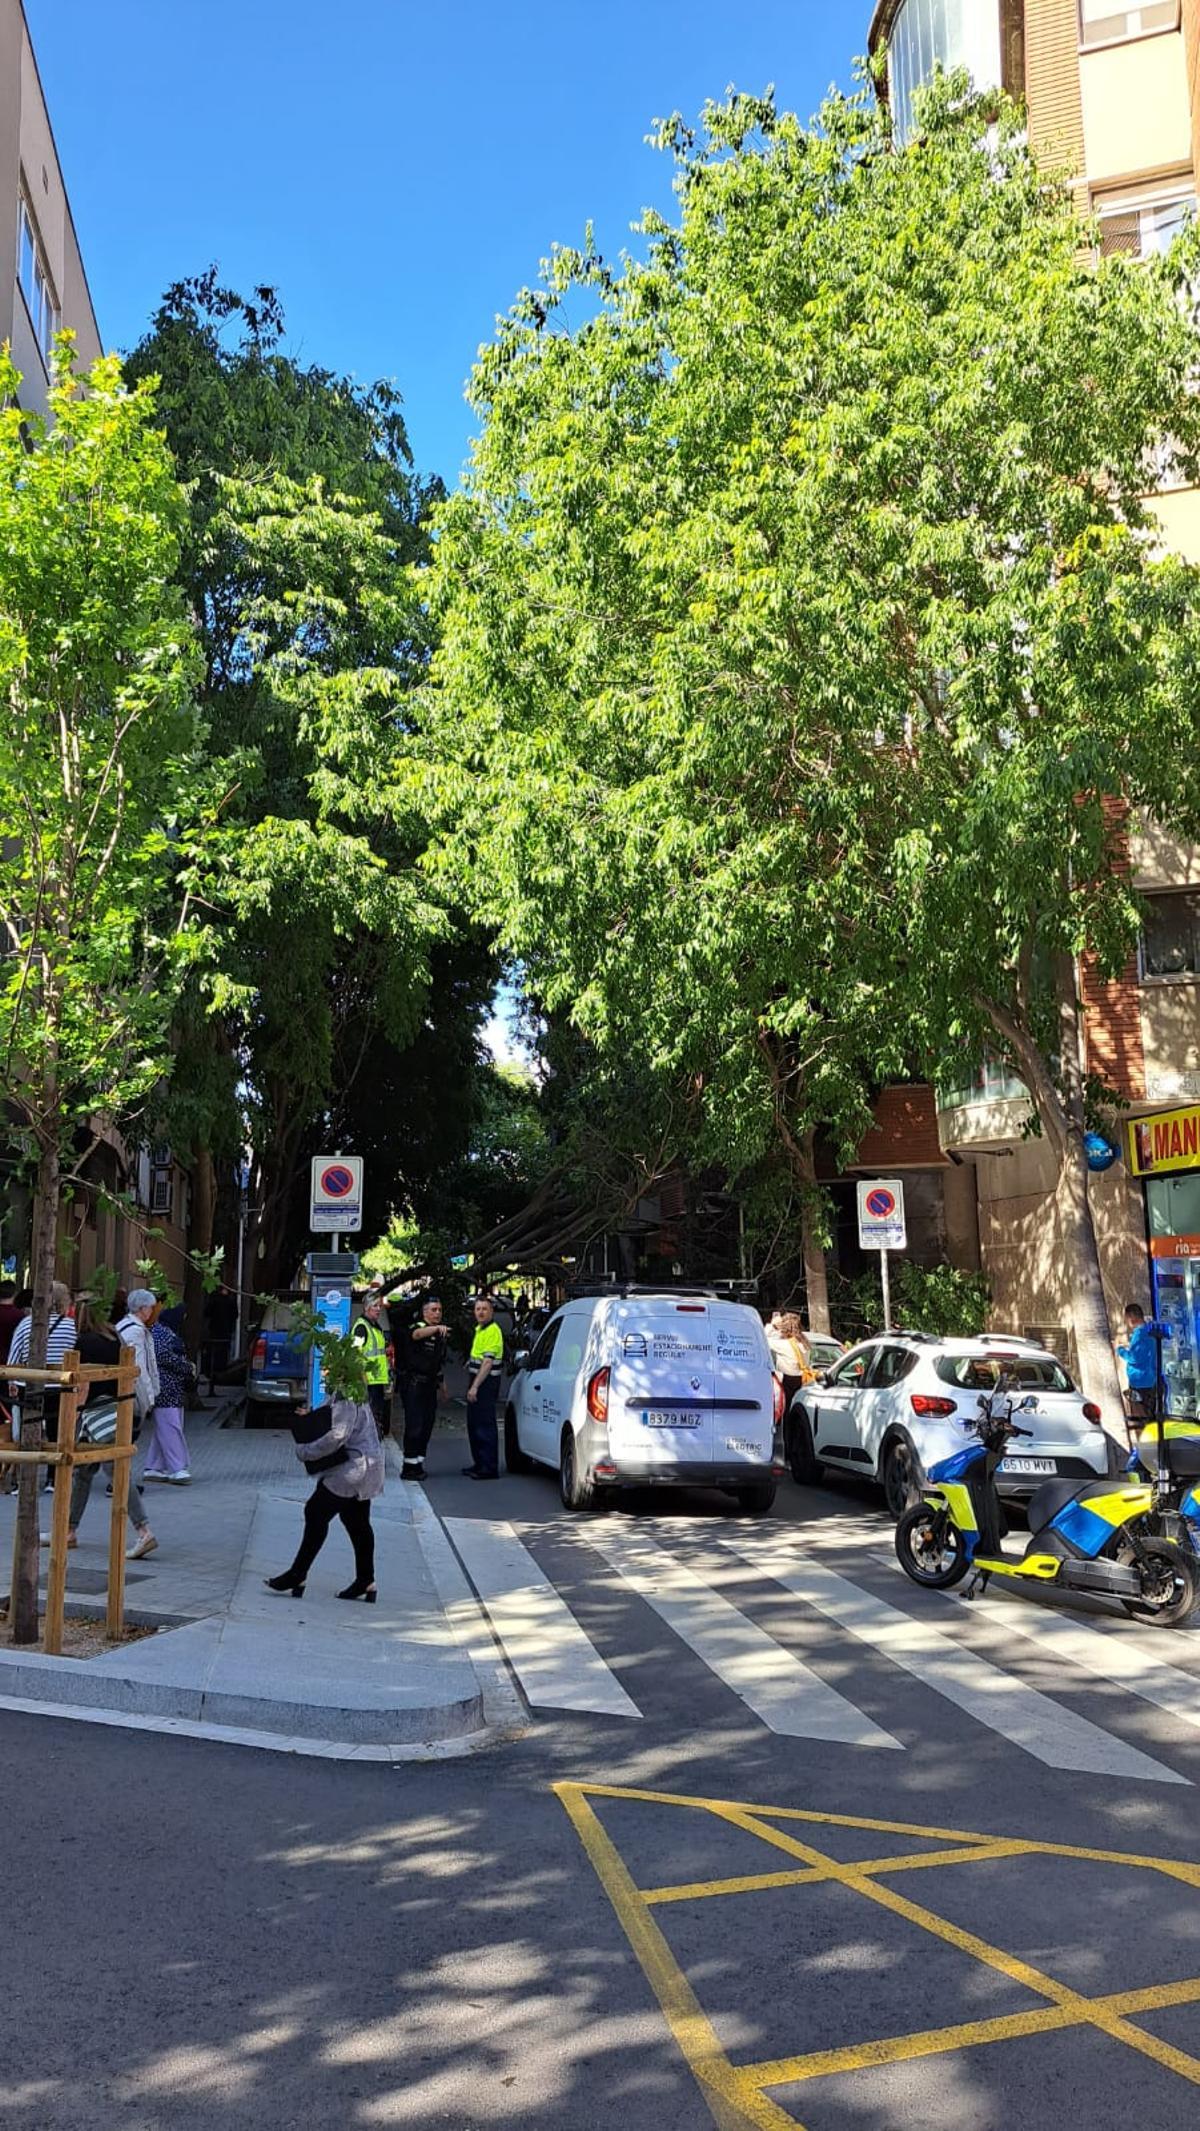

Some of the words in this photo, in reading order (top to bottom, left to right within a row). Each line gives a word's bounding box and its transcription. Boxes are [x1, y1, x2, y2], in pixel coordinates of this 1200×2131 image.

[1154, 1114, 1200, 1160] MAN
[1175, 1238, 1189, 1254] ria
[717, 1346, 748, 1357] Forum
[650, 1413, 677, 1424] 8379
[680, 1413, 701, 1425] MGZ
[1003, 1459, 1031, 1471] 6510
